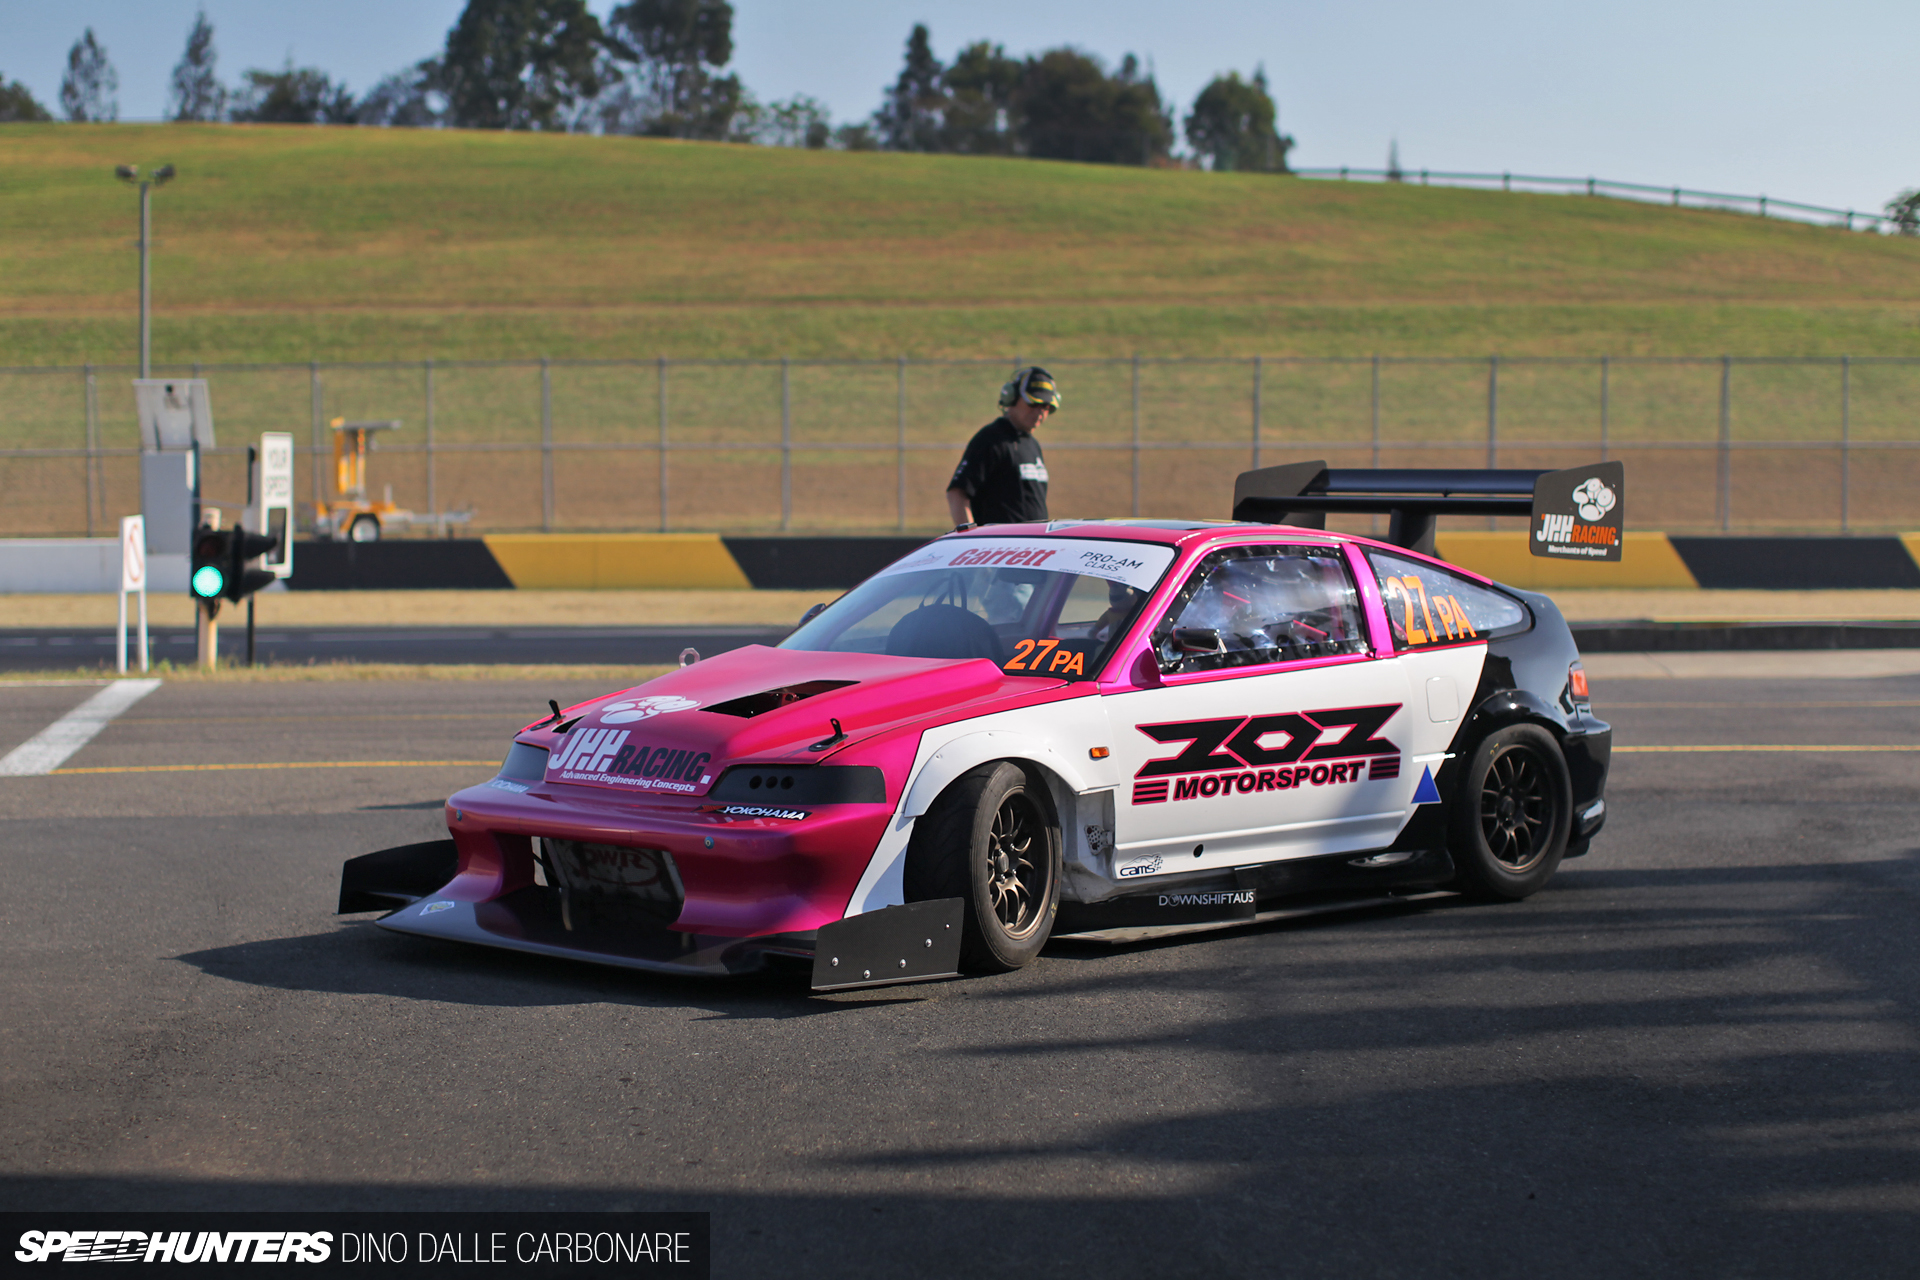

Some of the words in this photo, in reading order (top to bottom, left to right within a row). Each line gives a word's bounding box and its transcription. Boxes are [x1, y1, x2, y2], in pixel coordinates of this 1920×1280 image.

[948, 548, 1057, 566] Garrett
[1080, 551, 1144, 569] PRO-AM
[1084, 561, 1121, 571] CLASS
[1134, 702, 1403, 780] ZOZ
[559, 770, 601, 782] Advanced
[600, 773, 651, 788] Engineering
[651, 779, 696, 792] Concepts
[1173, 760, 1366, 801] MOTORSPORT
[723, 806, 805, 820] YOKOHAMA
[1120, 864, 1155, 877] cams
